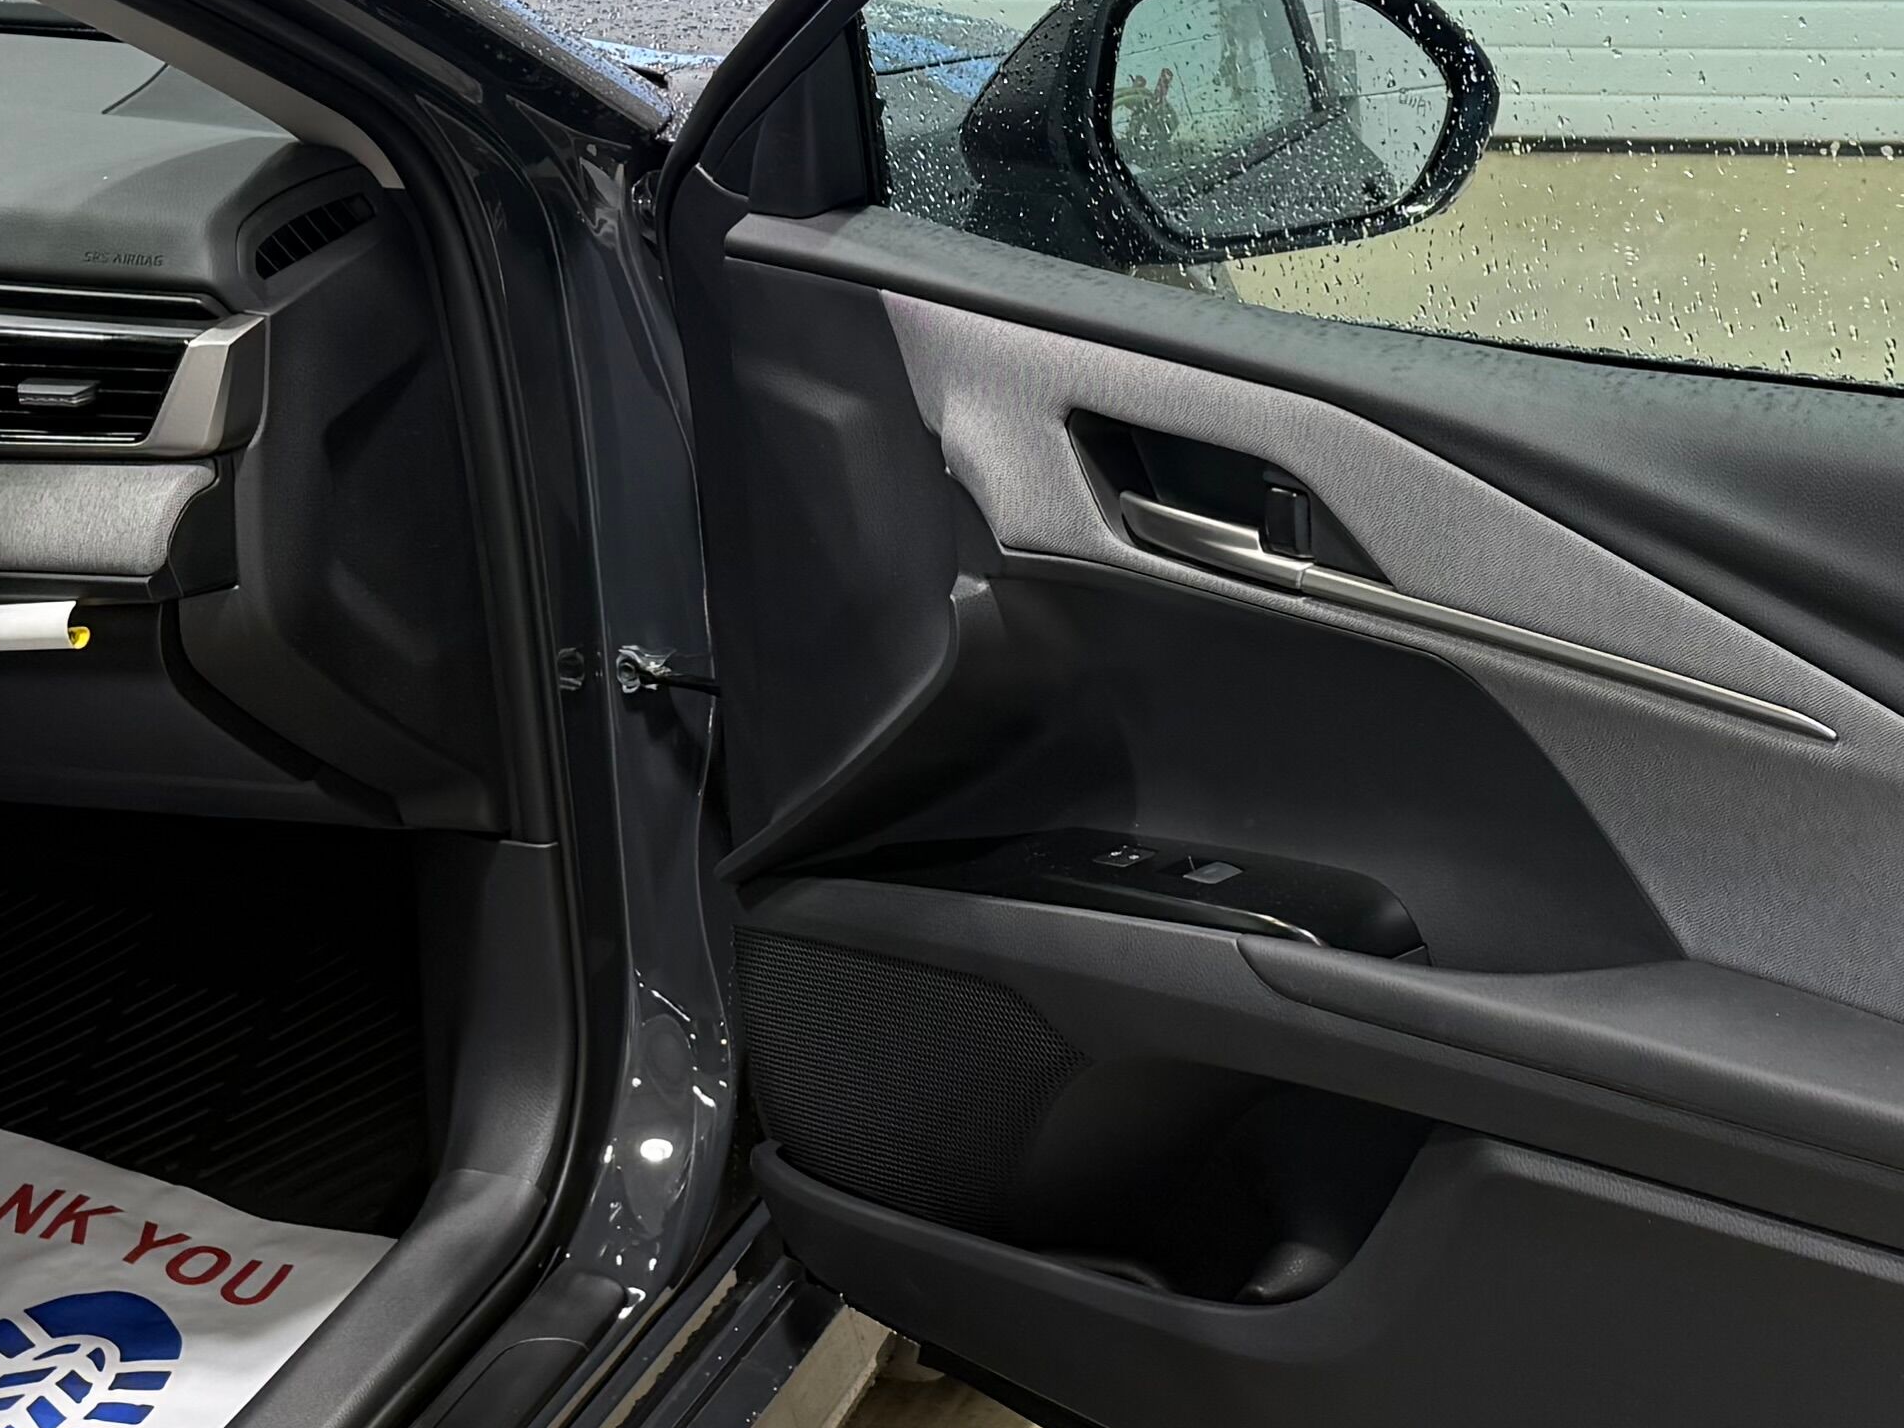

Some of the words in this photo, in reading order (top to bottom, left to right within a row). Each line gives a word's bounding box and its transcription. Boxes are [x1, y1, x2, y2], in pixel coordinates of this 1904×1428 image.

[83, 251, 110, 264] SRS
[112, 252, 164, 267] AIRBAG
[122, 1220, 294, 1306] YOU
